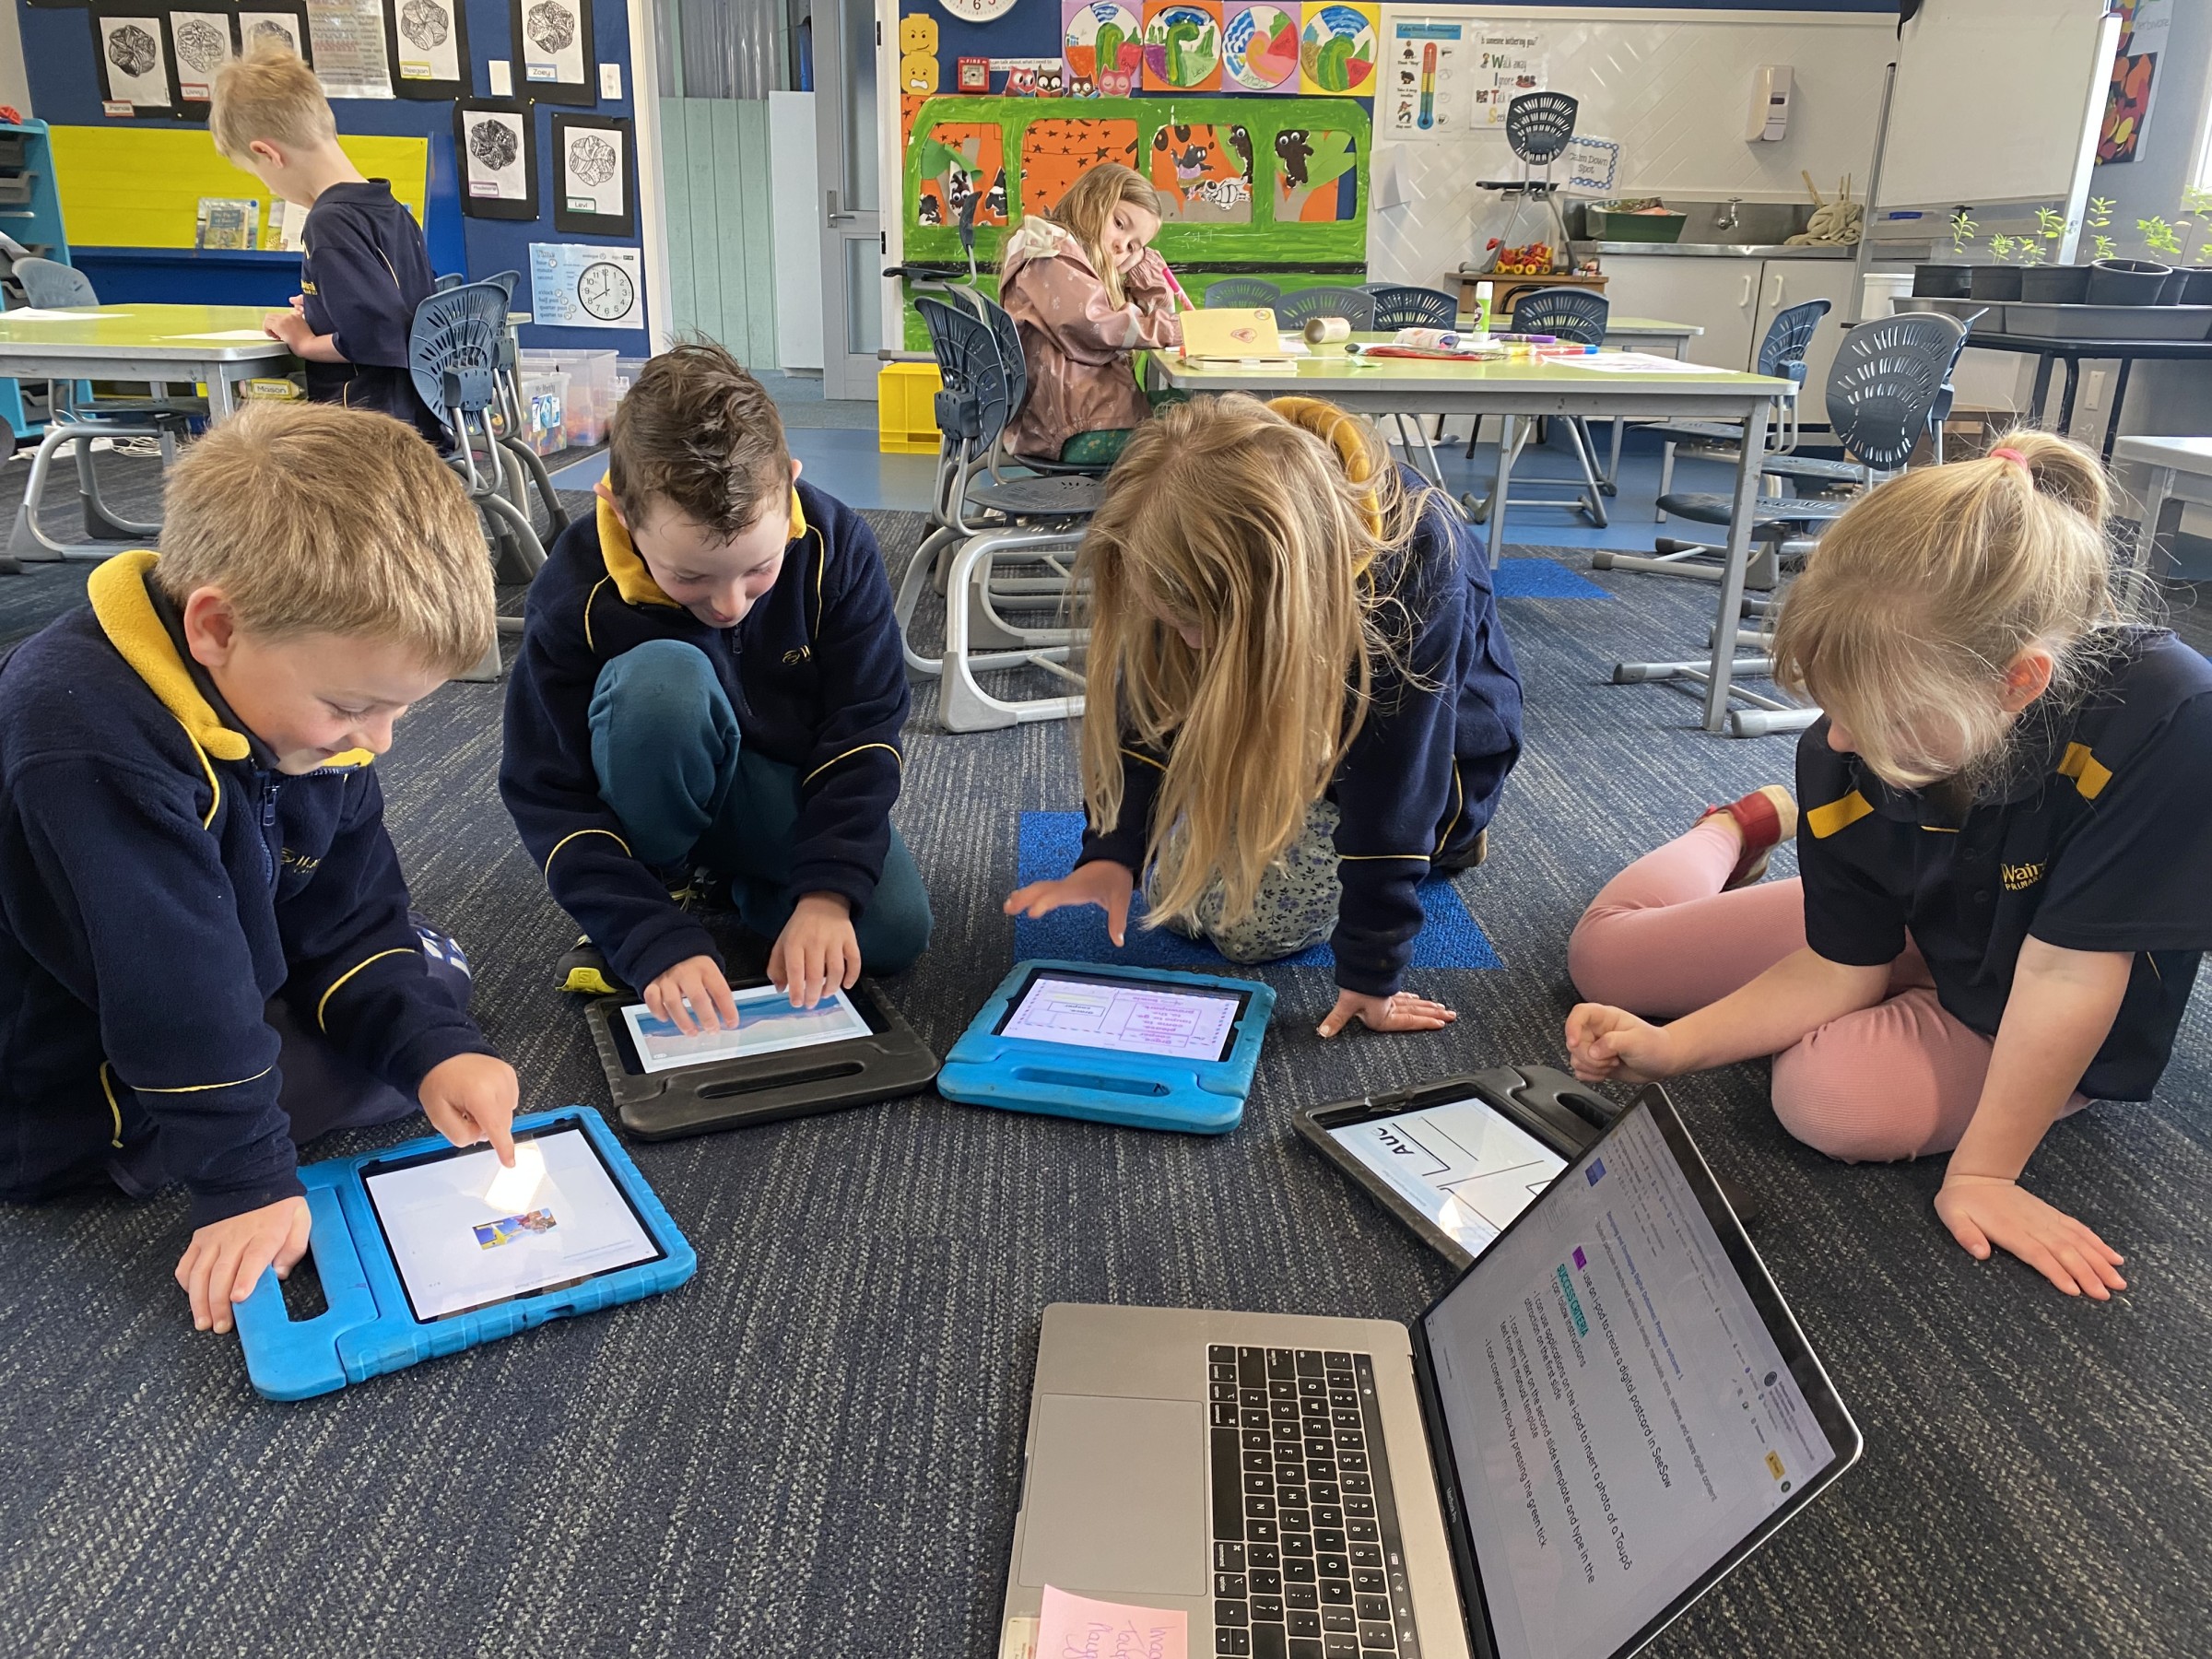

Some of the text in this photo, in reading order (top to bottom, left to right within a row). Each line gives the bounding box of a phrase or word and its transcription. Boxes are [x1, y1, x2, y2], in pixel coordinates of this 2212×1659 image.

[973, 0, 981, 10] 6
[533, 68, 551, 76] Zoey
[1491, 54, 1527, 73] Walk away
[1494, 72, 1514, 88] Ignore
[1491, 89, 1505, 104] Talk
[1578, 164, 1595, 174] Spot
[1588, 155, 1608, 166] Down
[256, 385, 287, 394] Mason
[1535, 1297, 1544, 1313] can
[1556, 1263, 1588, 1337] SUCCESS CRITERIA
[1510, 1322, 1519, 1338] can
[1539, 1312, 1548, 1328] use
[1551, 1281, 1560, 1297] can
[1557, 1294, 1568, 1319] follow
[1564, 1317, 1586, 1368] instructions
[1486, 1346, 1495, 1362] can
[1514, 1335, 1526, 1362] insert
[1524, 1297, 1561, 1400] attraction on the first slide
[1544, 1327, 1566, 1379] applications
[1522, 1359, 1532, 1378] text
[1489, 1361, 1505, 1399] complete
[1499, 1320, 1538, 1439] text from my manual template
[1526, 1377, 1535, 1390] on
[1561, 1377, 1570, 1391] on
[1583, 1274, 1592, 1288] use
[1588, 1286, 1596, 1299] an
[1592, 1296, 1606, 1320] i-pad
[1601, 1318, 1609, 1330] to
[1605, 1329, 1620, 1358] create
[1618, 1364, 1636, 1394] digital
[1628, 1394, 1653, 1437] postcard
[1646, 1436, 1655, 1449] in
[1651, 1446, 1671, 1488] SeeSaw
[1500, 1398, 1508, 1413] my
[1530, 1387, 1540, 1406] the
[1566, 1388, 1575, 1406] the
[1504, 1409, 1513, 1430] box
[1535, 1404, 1551, 1437] second
[1571, 1404, 1585, 1431] i-pad
[1509, 1426, 1516, 1441] by
[1579, 1429, 1587, 1442] to
[1546, 1437, 1558, 1461] slide
[1583, 1440, 1598, 1473] insert
[1511, 1441, 1527, 1482] pressing
[1523, 1478, 1533, 1499] the
[1552, 1458, 1571, 1504] template
[1594, 1480, 1611, 1512] photo
[1525, 1498, 1540, 1528] green
[1565, 1503, 1579, 1525] and
[1606, 1512, 1618, 1524] of
[1535, 1525, 1547, 1548] tick
[1571, 1524, 1584, 1551] type
[1580, 1547, 1588, 1563] in
[1615, 1531, 1632, 1571] Taupō
[1583, 1561, 1594, 1583] the
